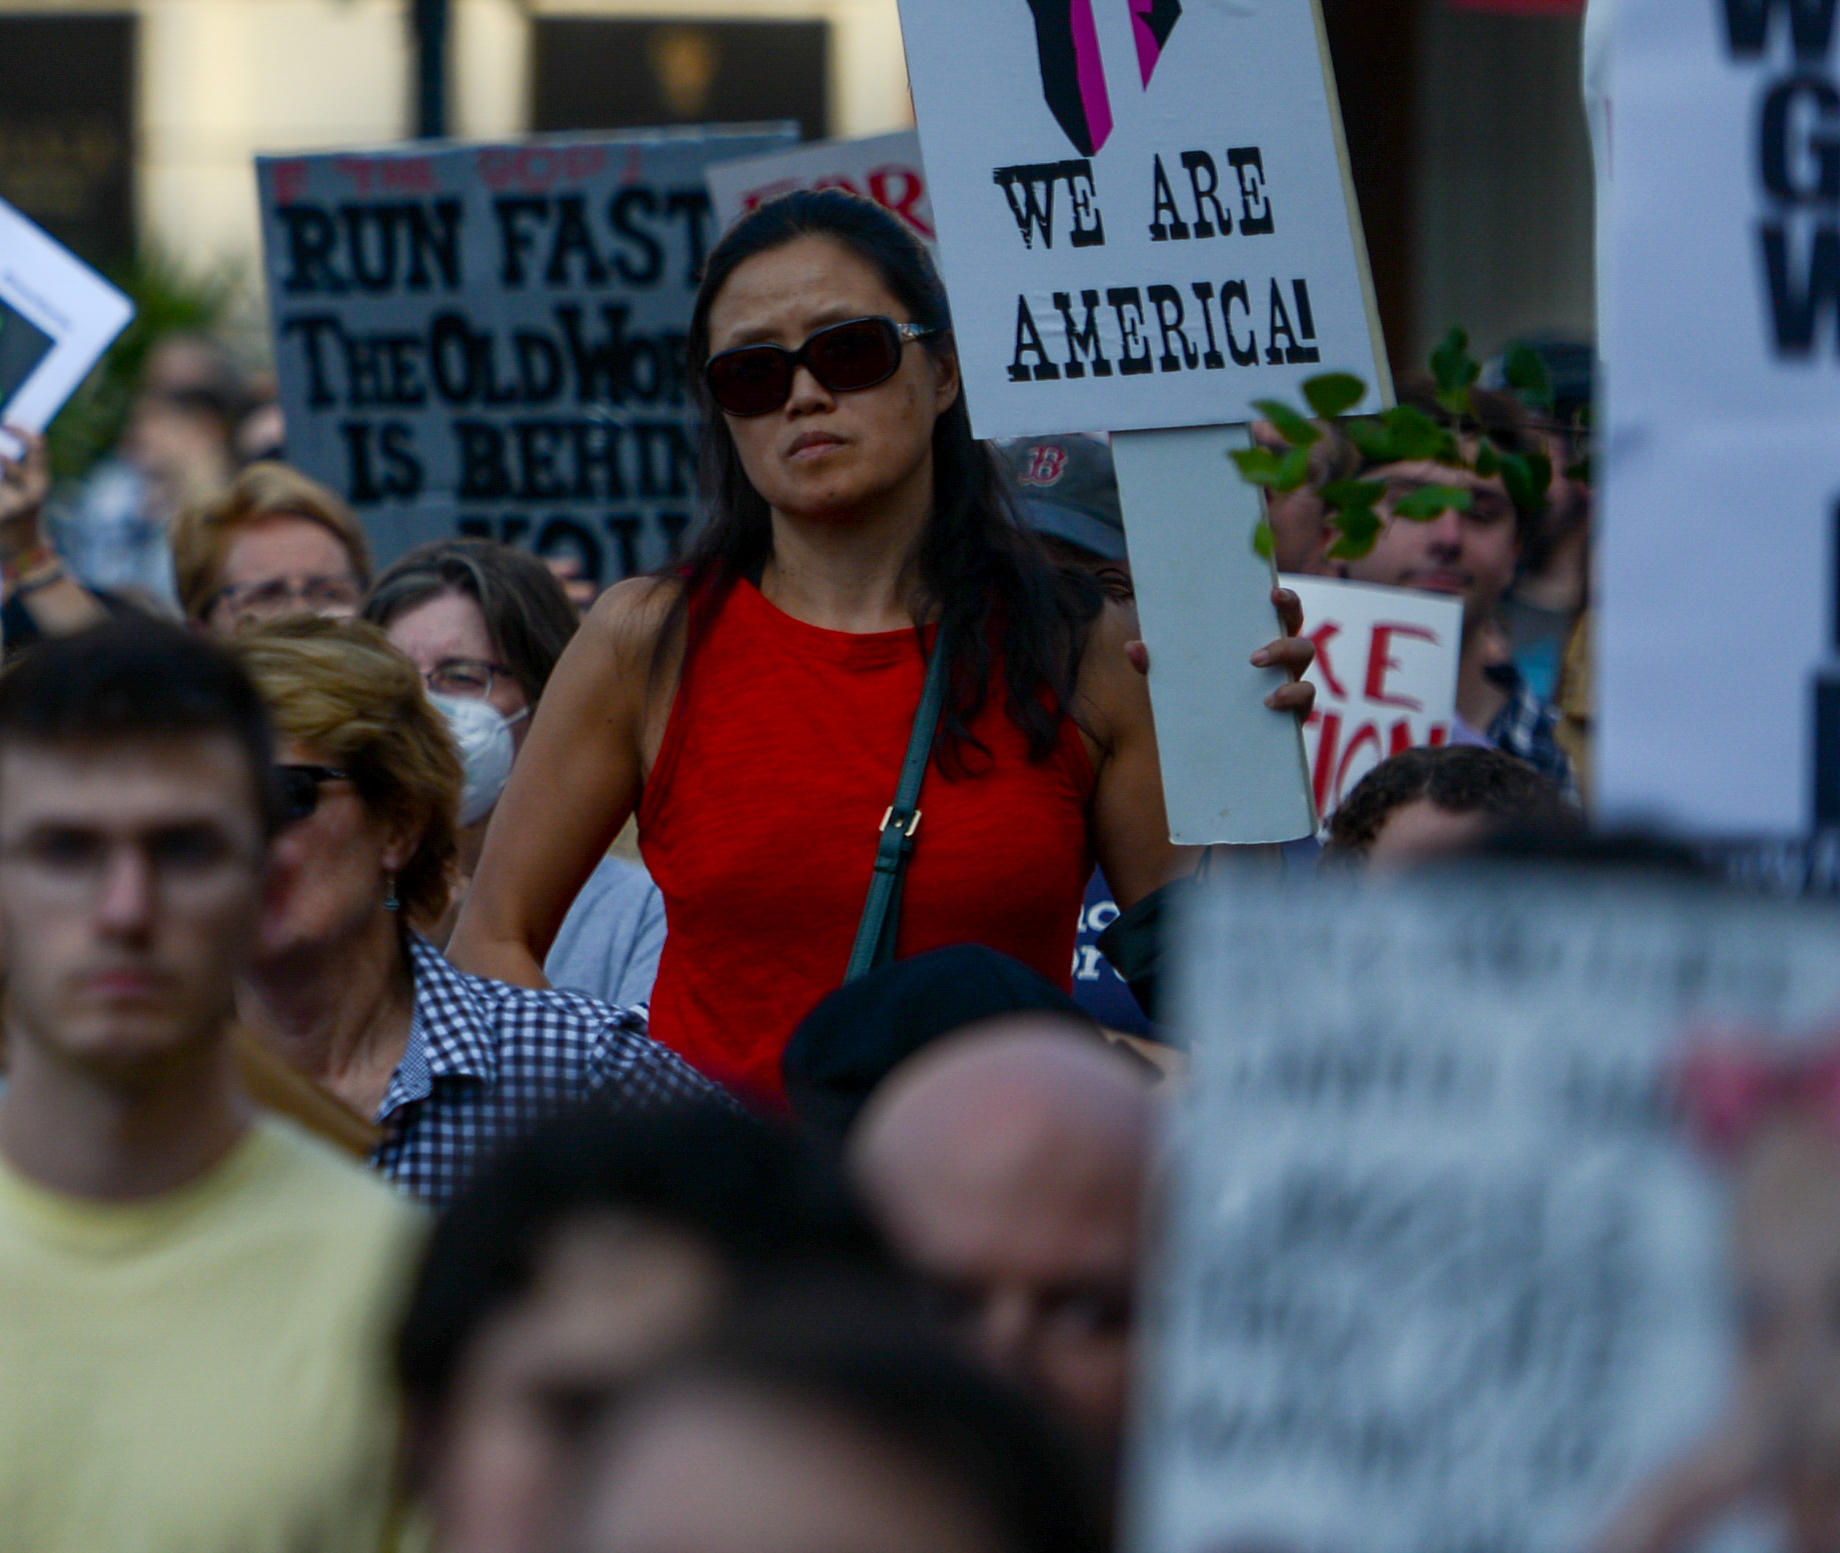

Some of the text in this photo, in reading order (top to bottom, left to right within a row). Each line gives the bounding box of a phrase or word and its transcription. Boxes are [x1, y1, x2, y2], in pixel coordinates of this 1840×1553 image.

[277, 194, 464, 296] RUN
[492, 185, 712, 288] FAST
[992, 159, 1105, 249] WE
[1148, 147, 1275, 241] ARE
[1007, 277, 1320, 383] AMERICA!
[341, 418, 425, 504] IS
[1019, 444, 1069, 488] B
